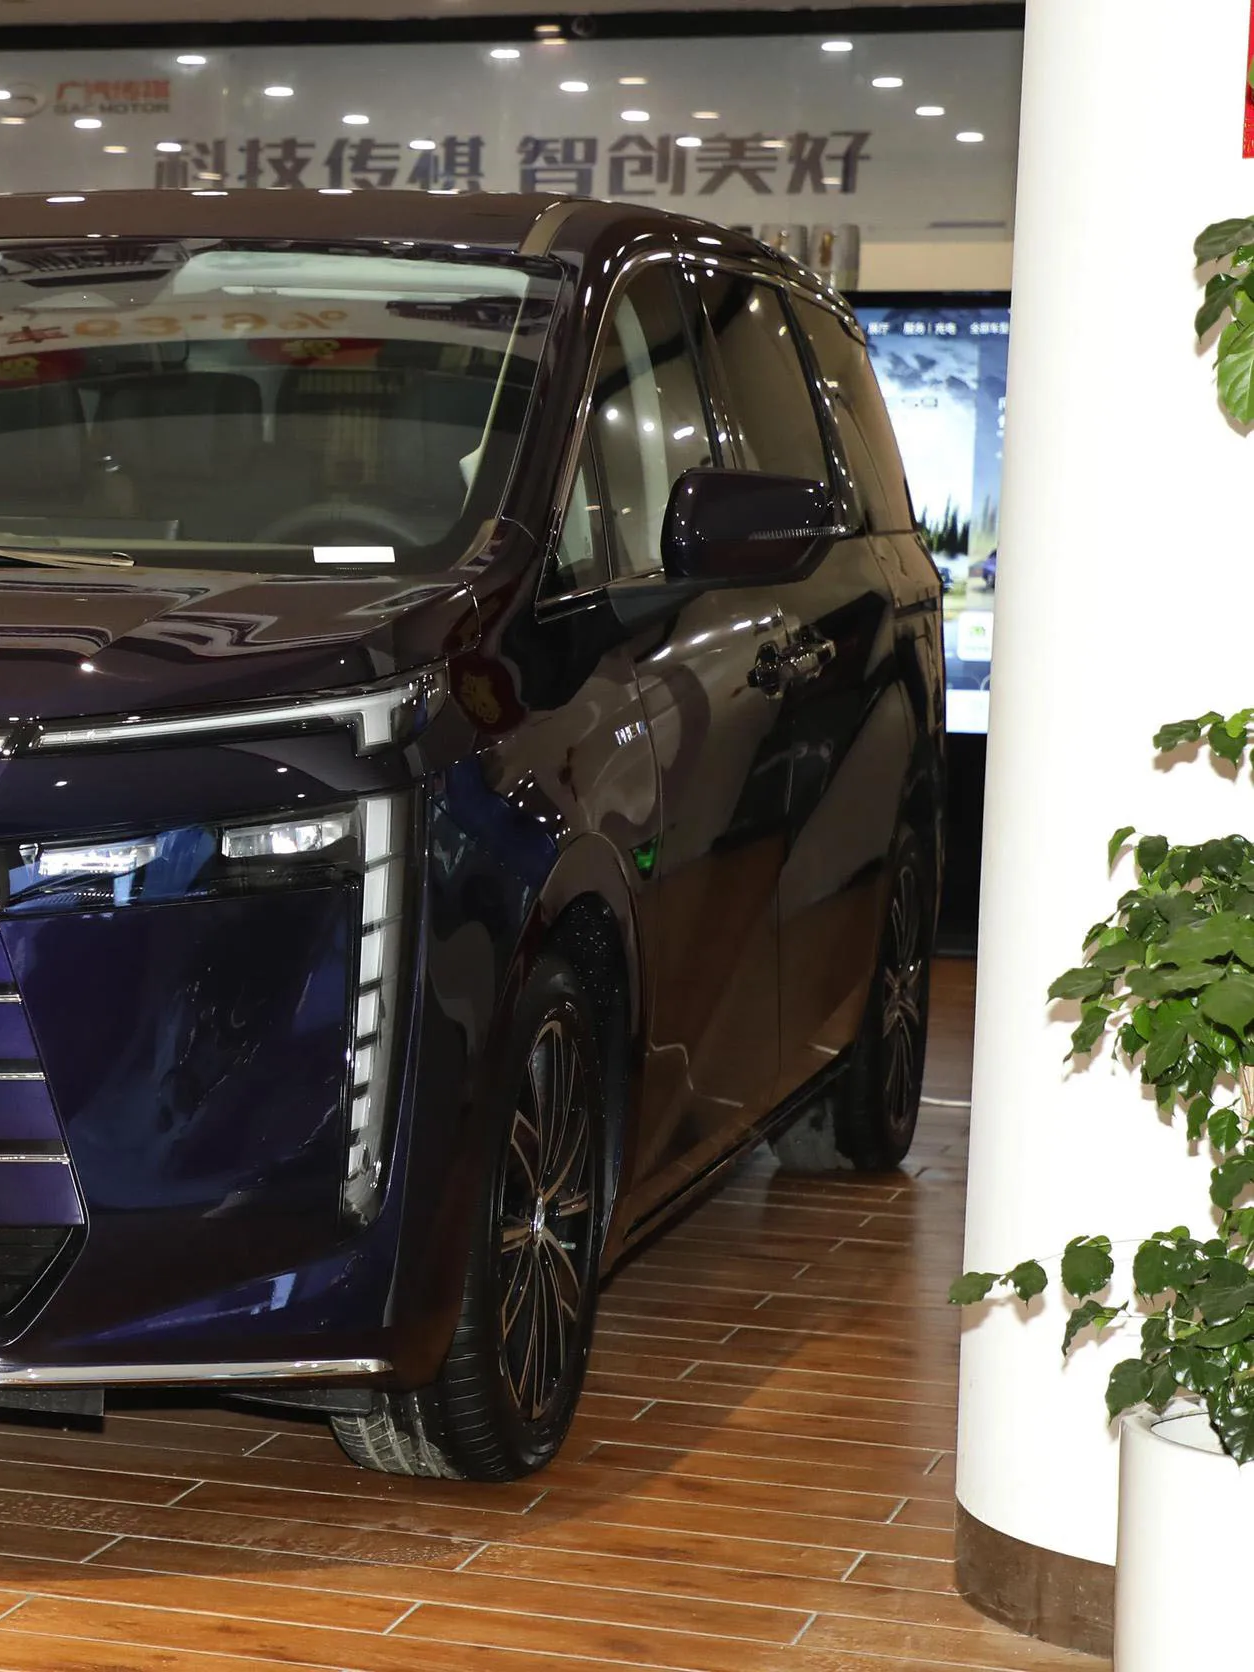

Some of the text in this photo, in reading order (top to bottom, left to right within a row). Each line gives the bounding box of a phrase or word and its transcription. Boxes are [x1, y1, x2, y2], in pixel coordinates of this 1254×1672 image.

[98, 103, 170, 115] MOTOR
[155, 131, 872, 196] 科技传祺 智创美好
